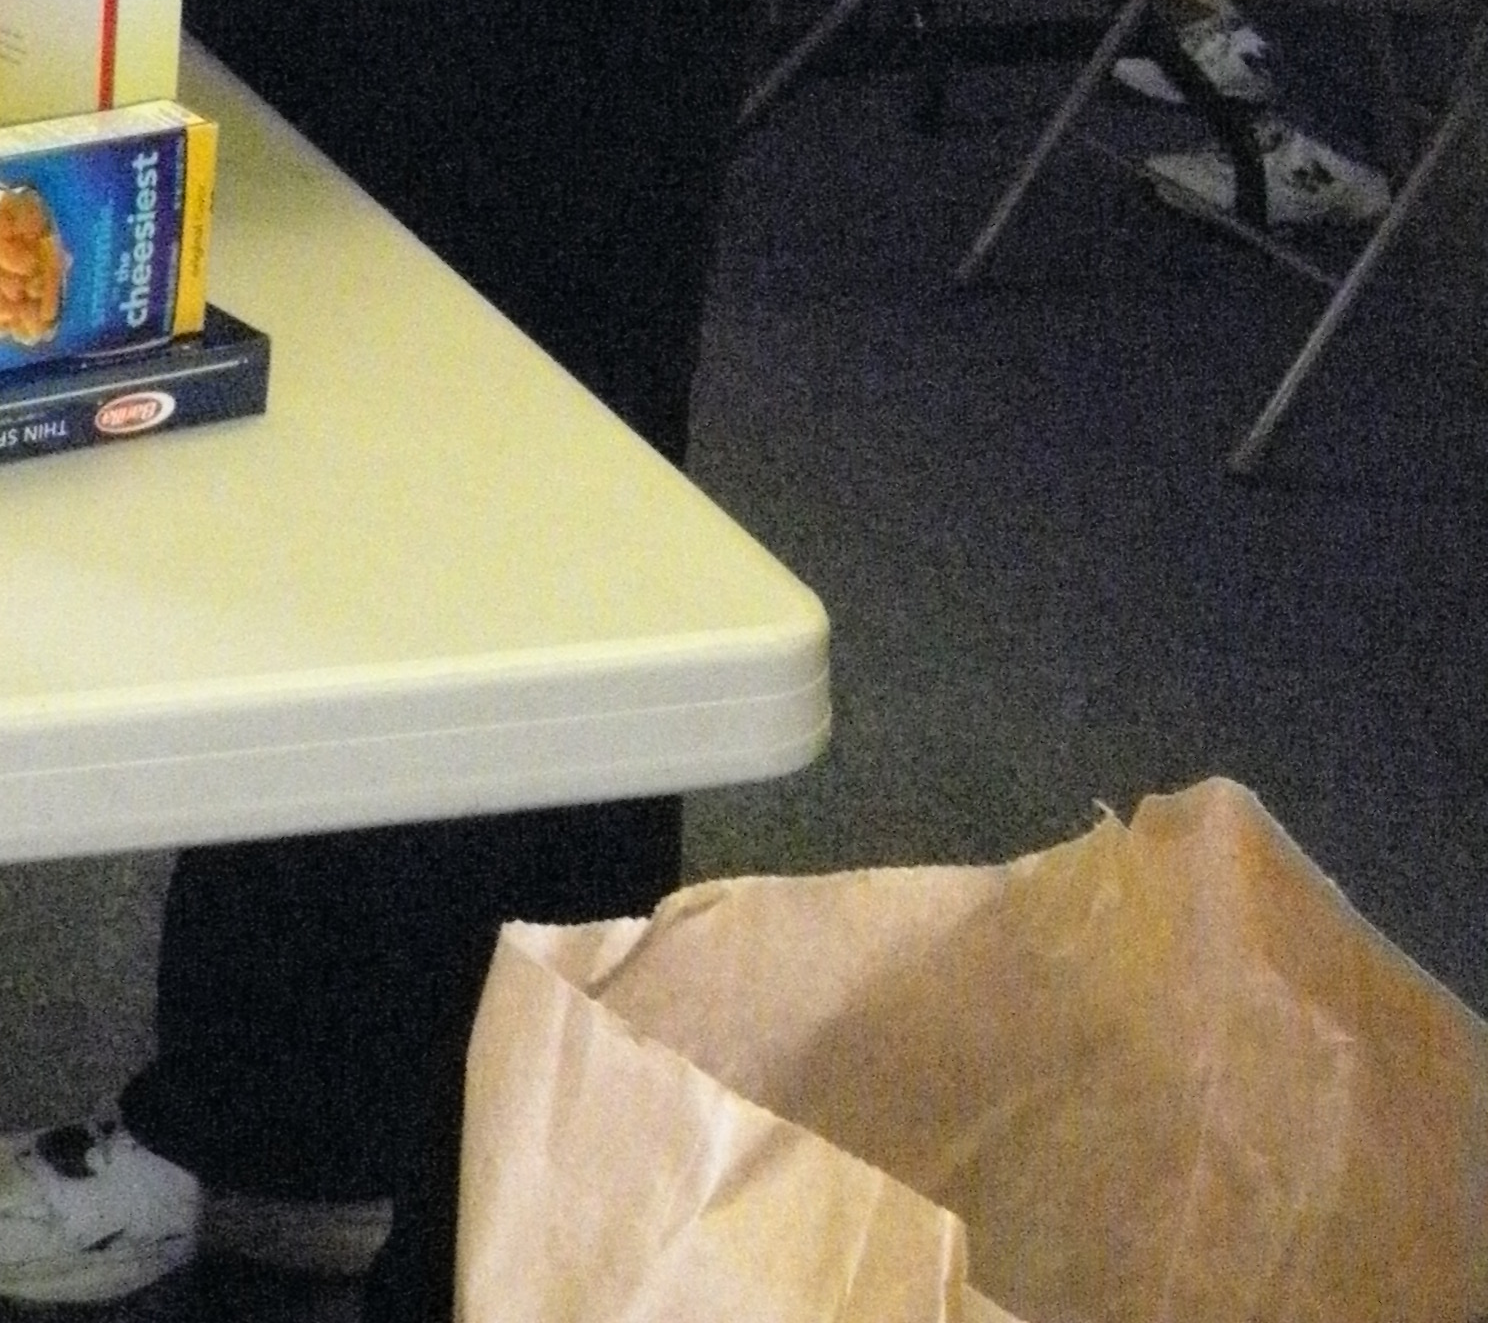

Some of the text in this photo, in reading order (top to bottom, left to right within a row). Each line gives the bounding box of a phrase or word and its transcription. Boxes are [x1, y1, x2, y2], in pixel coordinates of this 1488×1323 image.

[118, 151, 160, 329] cheesiest
[115, 252, 132, 284] the
[23, 419, 69, 442] THIN
